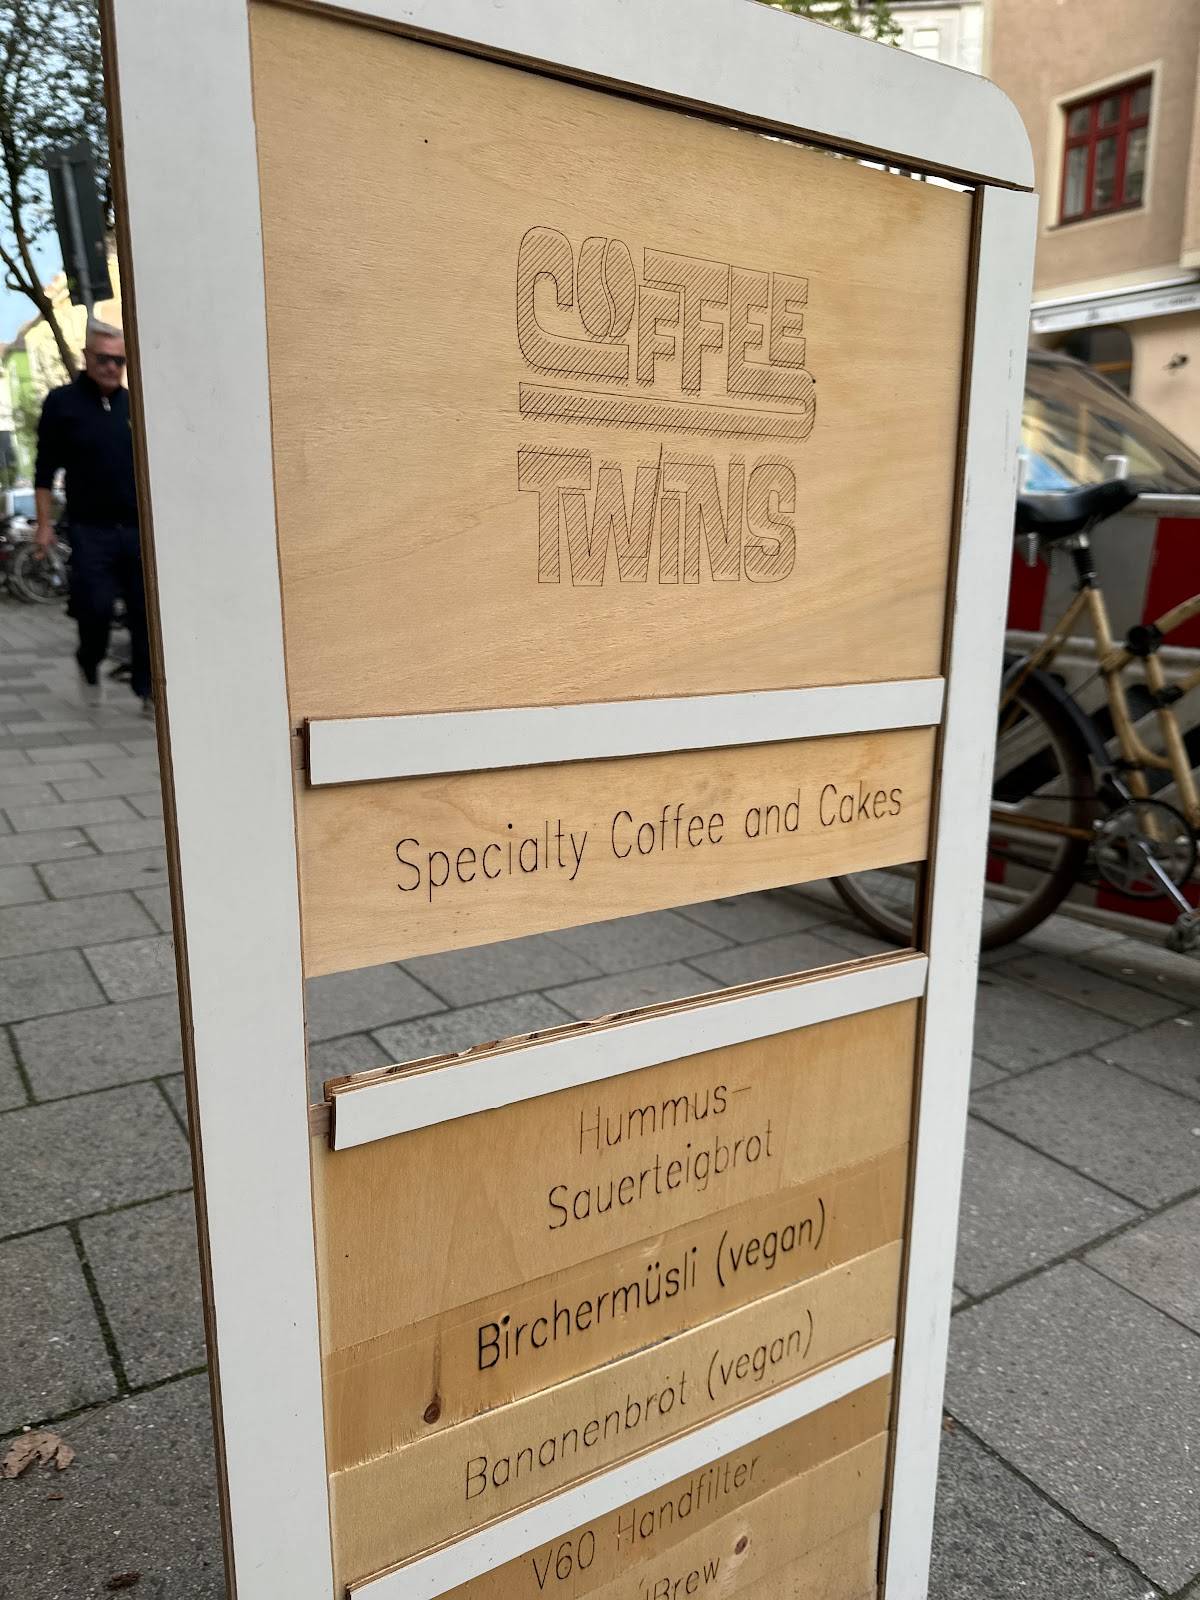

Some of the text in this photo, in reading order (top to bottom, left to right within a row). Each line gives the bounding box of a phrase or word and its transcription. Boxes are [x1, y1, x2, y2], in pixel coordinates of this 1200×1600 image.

[517, 226, 816, 440] COFFEE
[517, 444, 796, 587] TWINS
[396, 781, 904, 903] Specialty Coffee and Cakes
[548, 1119, 773, 1230] Sauerteigbrot
[579, 1085, 752, 1155] Hummus-
[478, 1198, 826, 1371] Birchermüsli (vegan)
[465, 1309, 814, 1501] Bananenbrot (vegan)
[532, 1456, 760, 1590] V60 Handfilter
